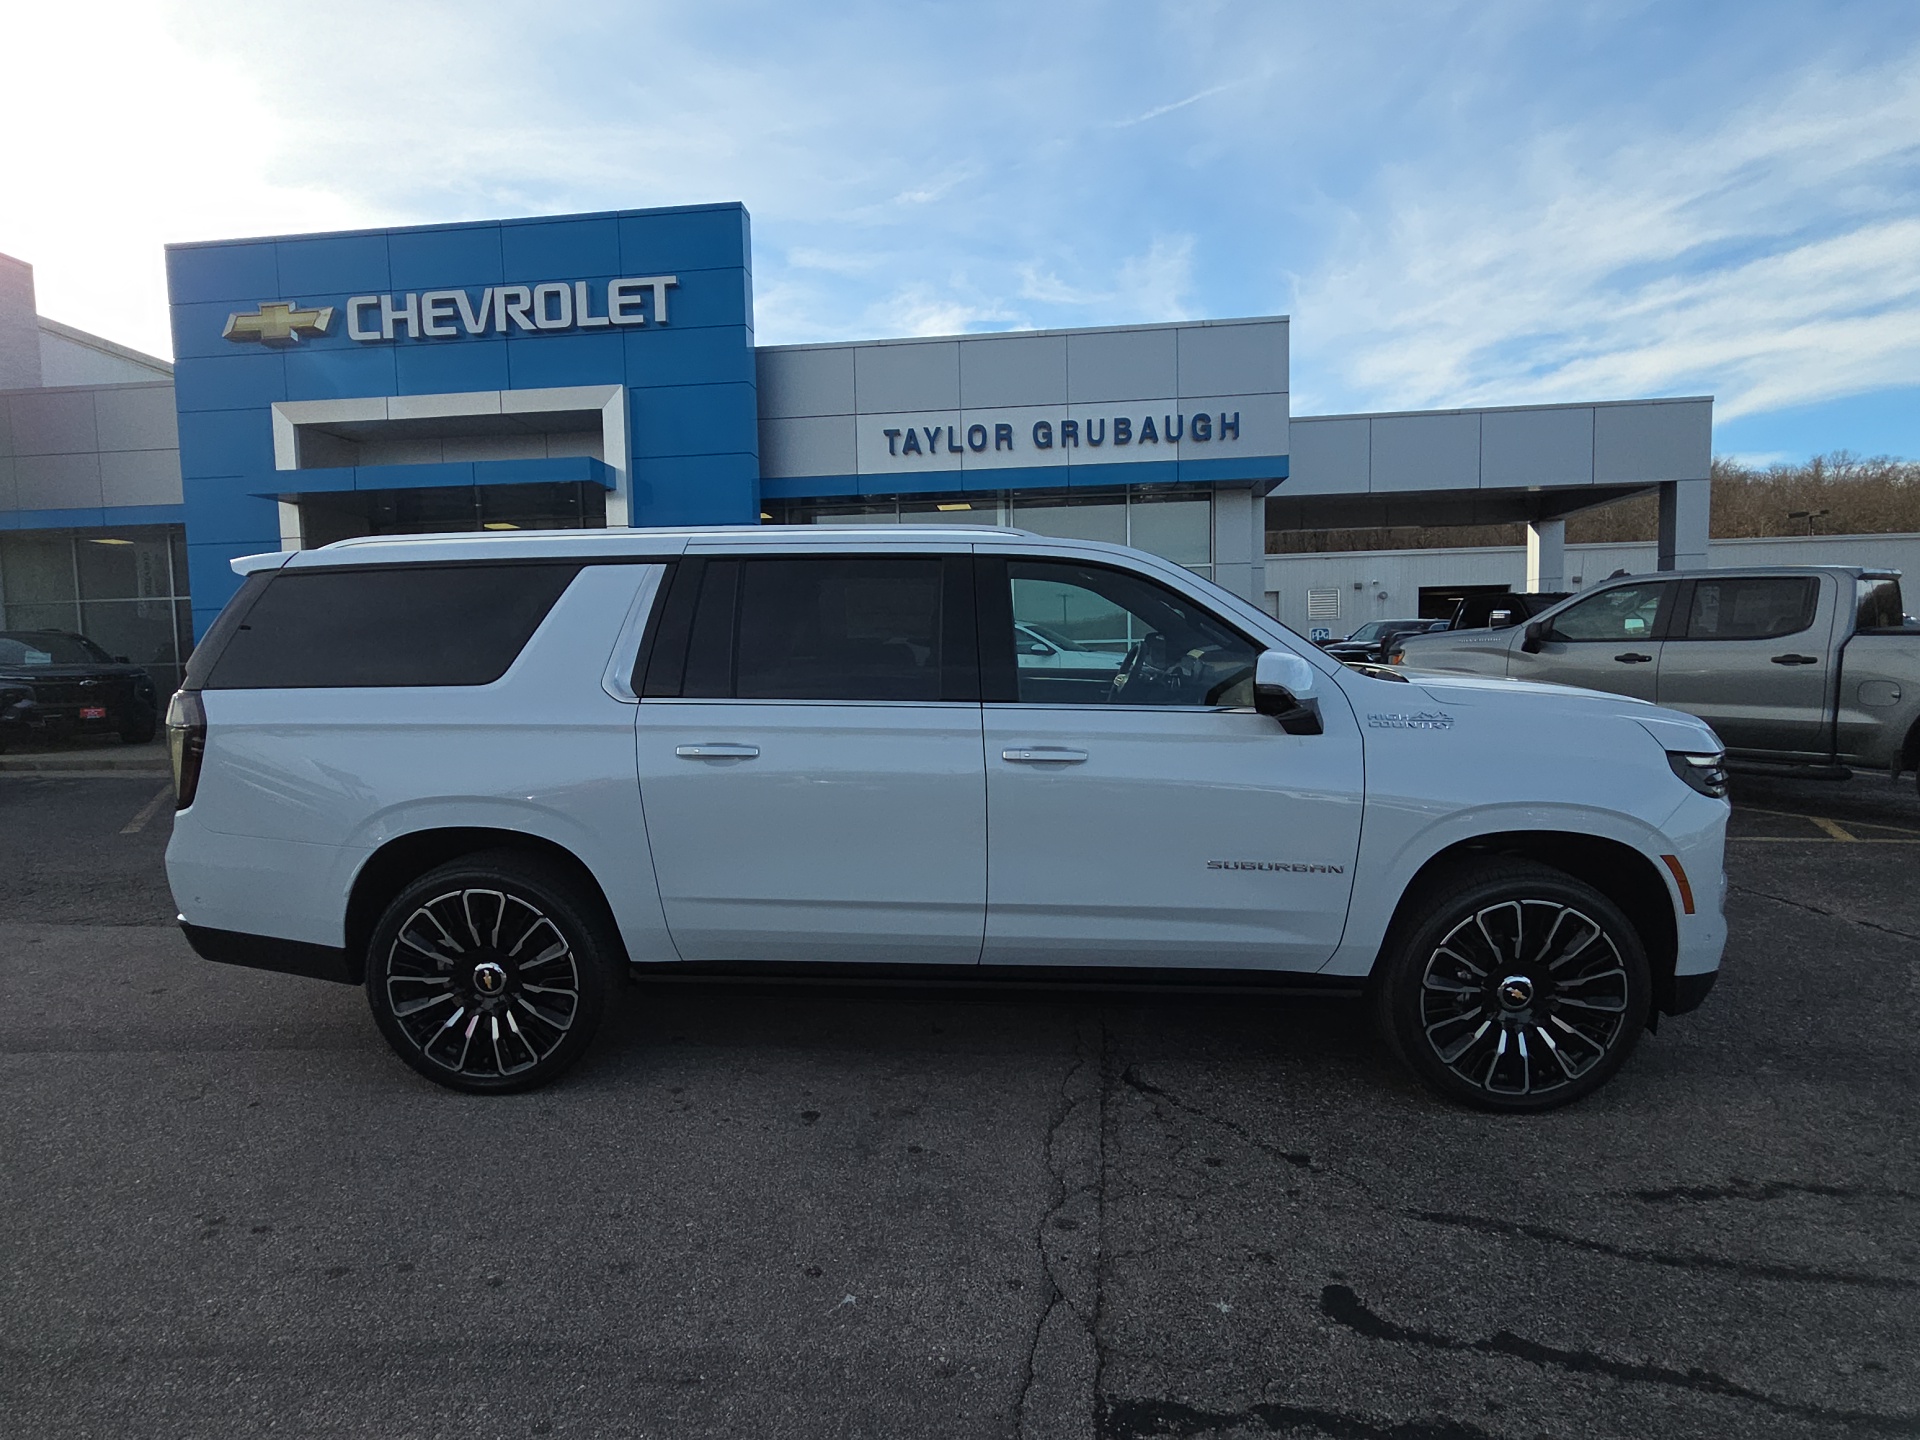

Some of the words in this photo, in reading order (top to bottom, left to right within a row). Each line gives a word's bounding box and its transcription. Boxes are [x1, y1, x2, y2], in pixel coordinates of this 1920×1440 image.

[346, 275, 678, 342] CHEVROLET
[883, 423, 1014, 456] TAYLOR
[1031, 411, 1241, 450] GRUBAUGH
[1311, 629, 1329, 640] PPG
[1368, 721, 1453, 730] COUNTRY
[1206, 860, 1345, 874] SUBURBAN
